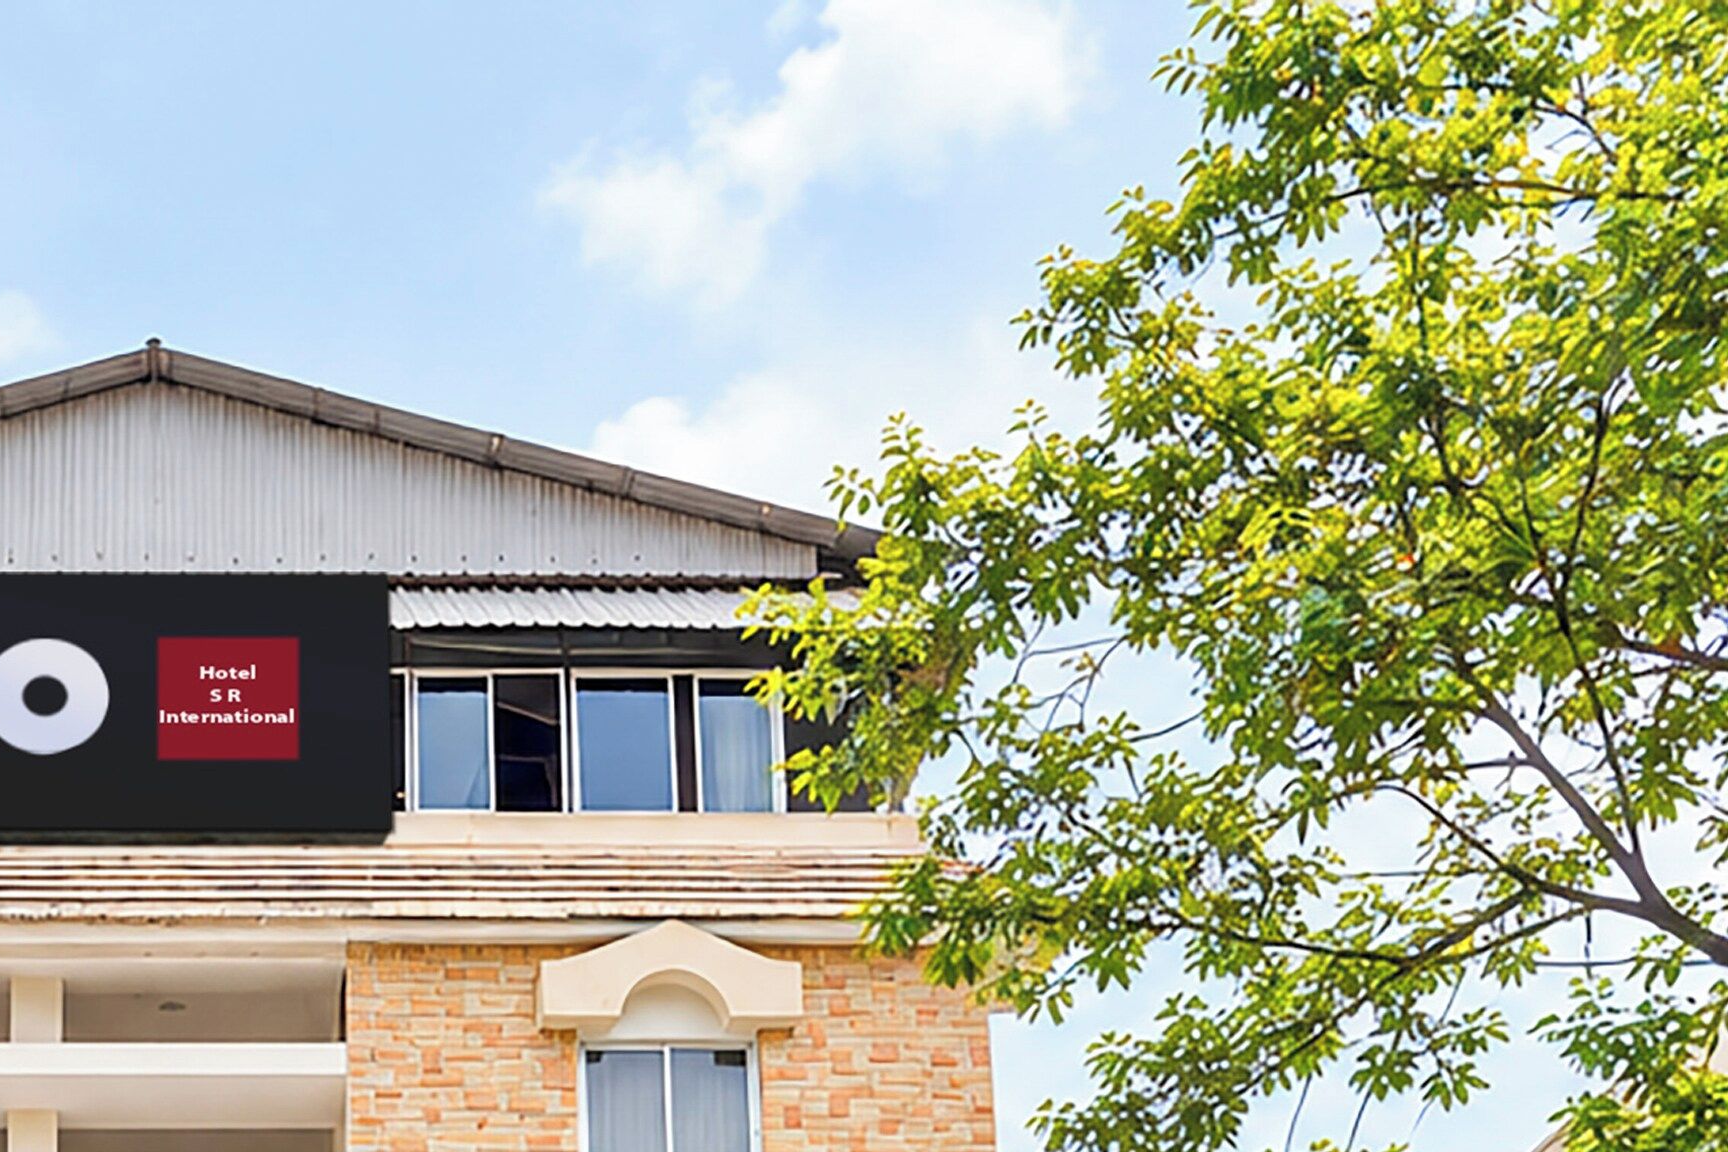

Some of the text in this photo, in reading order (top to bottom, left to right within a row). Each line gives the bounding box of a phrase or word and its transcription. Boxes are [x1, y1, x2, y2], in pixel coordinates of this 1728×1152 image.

[199, 664, 257, 680] Hotel
[209, 688, 242, 703] S R
[159, 707, 296, 724] International
